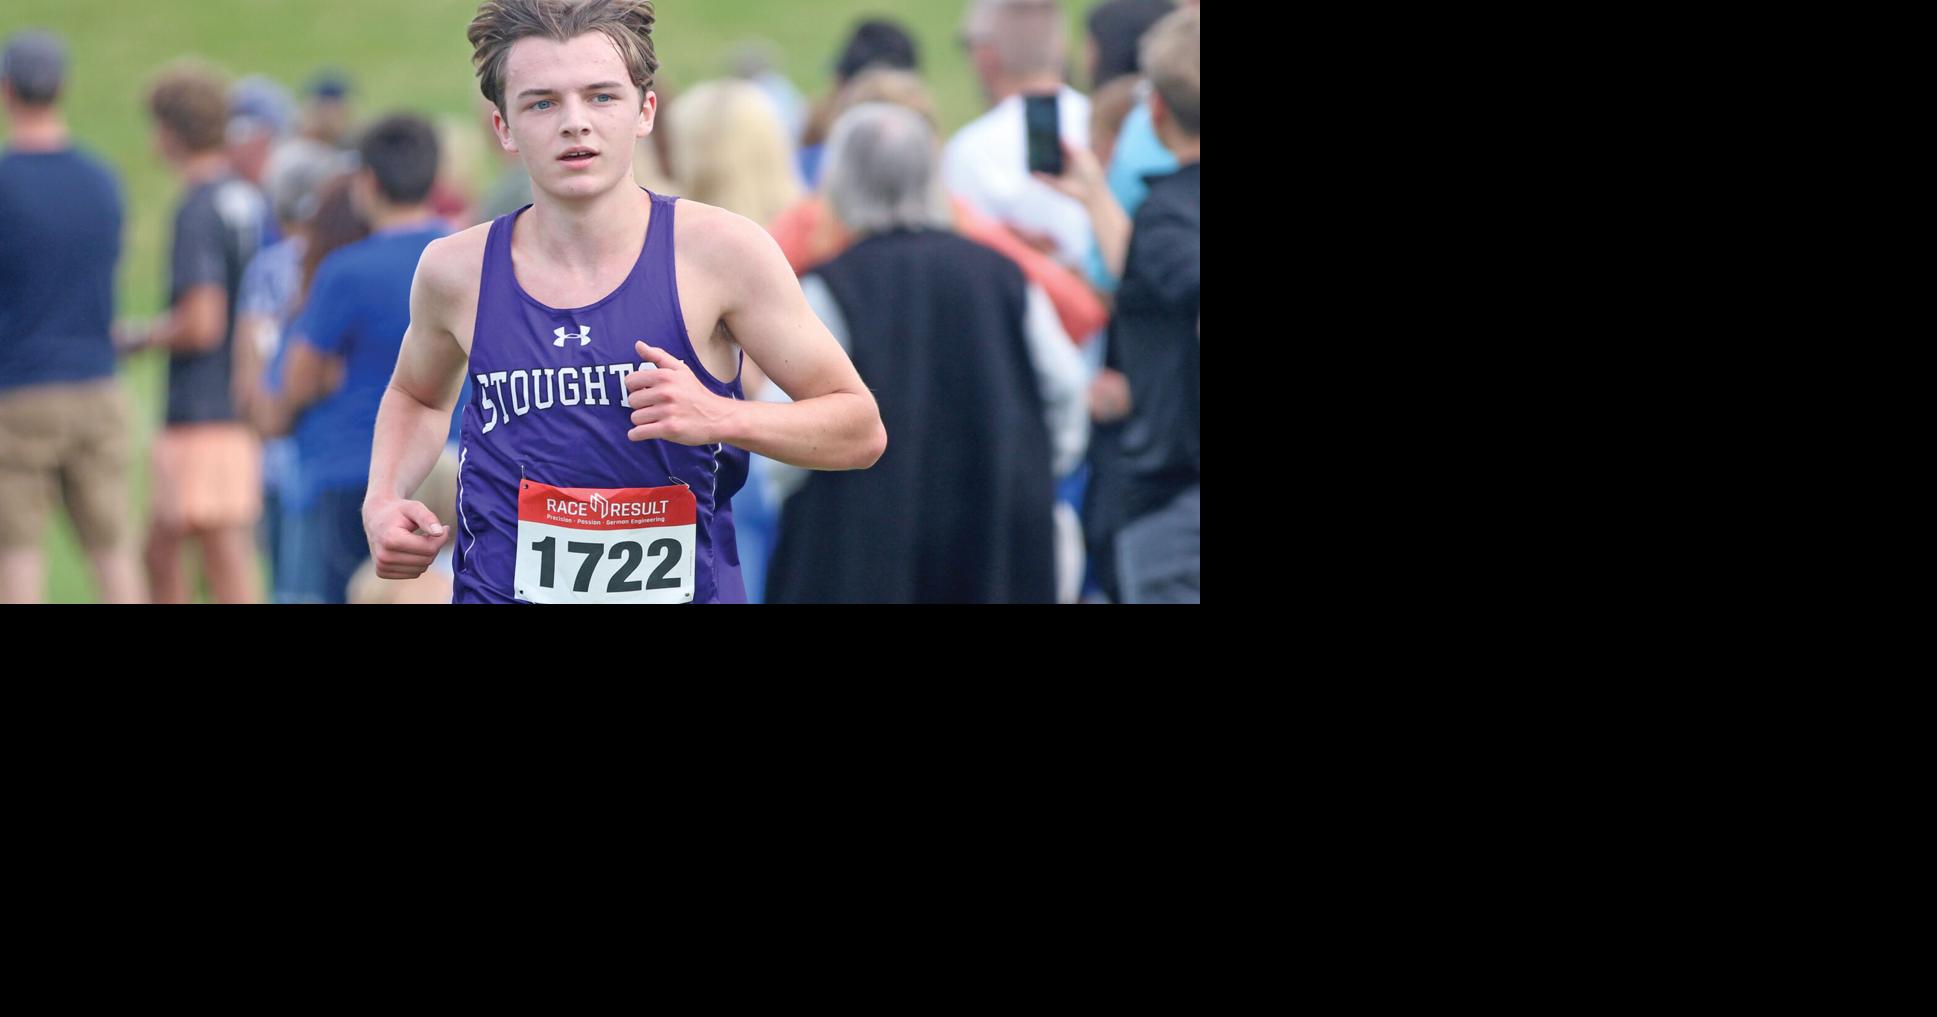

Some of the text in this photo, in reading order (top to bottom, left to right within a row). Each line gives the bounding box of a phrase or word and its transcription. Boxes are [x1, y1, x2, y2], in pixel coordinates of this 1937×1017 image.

[476, 360, 684, 434] STOUGHT
[546, 498, 669, 517] RACE RESULT
[546, 514, 572, 523] Precision
[630, 516, 665, 525] Engineering
[531, 536, 682, 593] 1722
